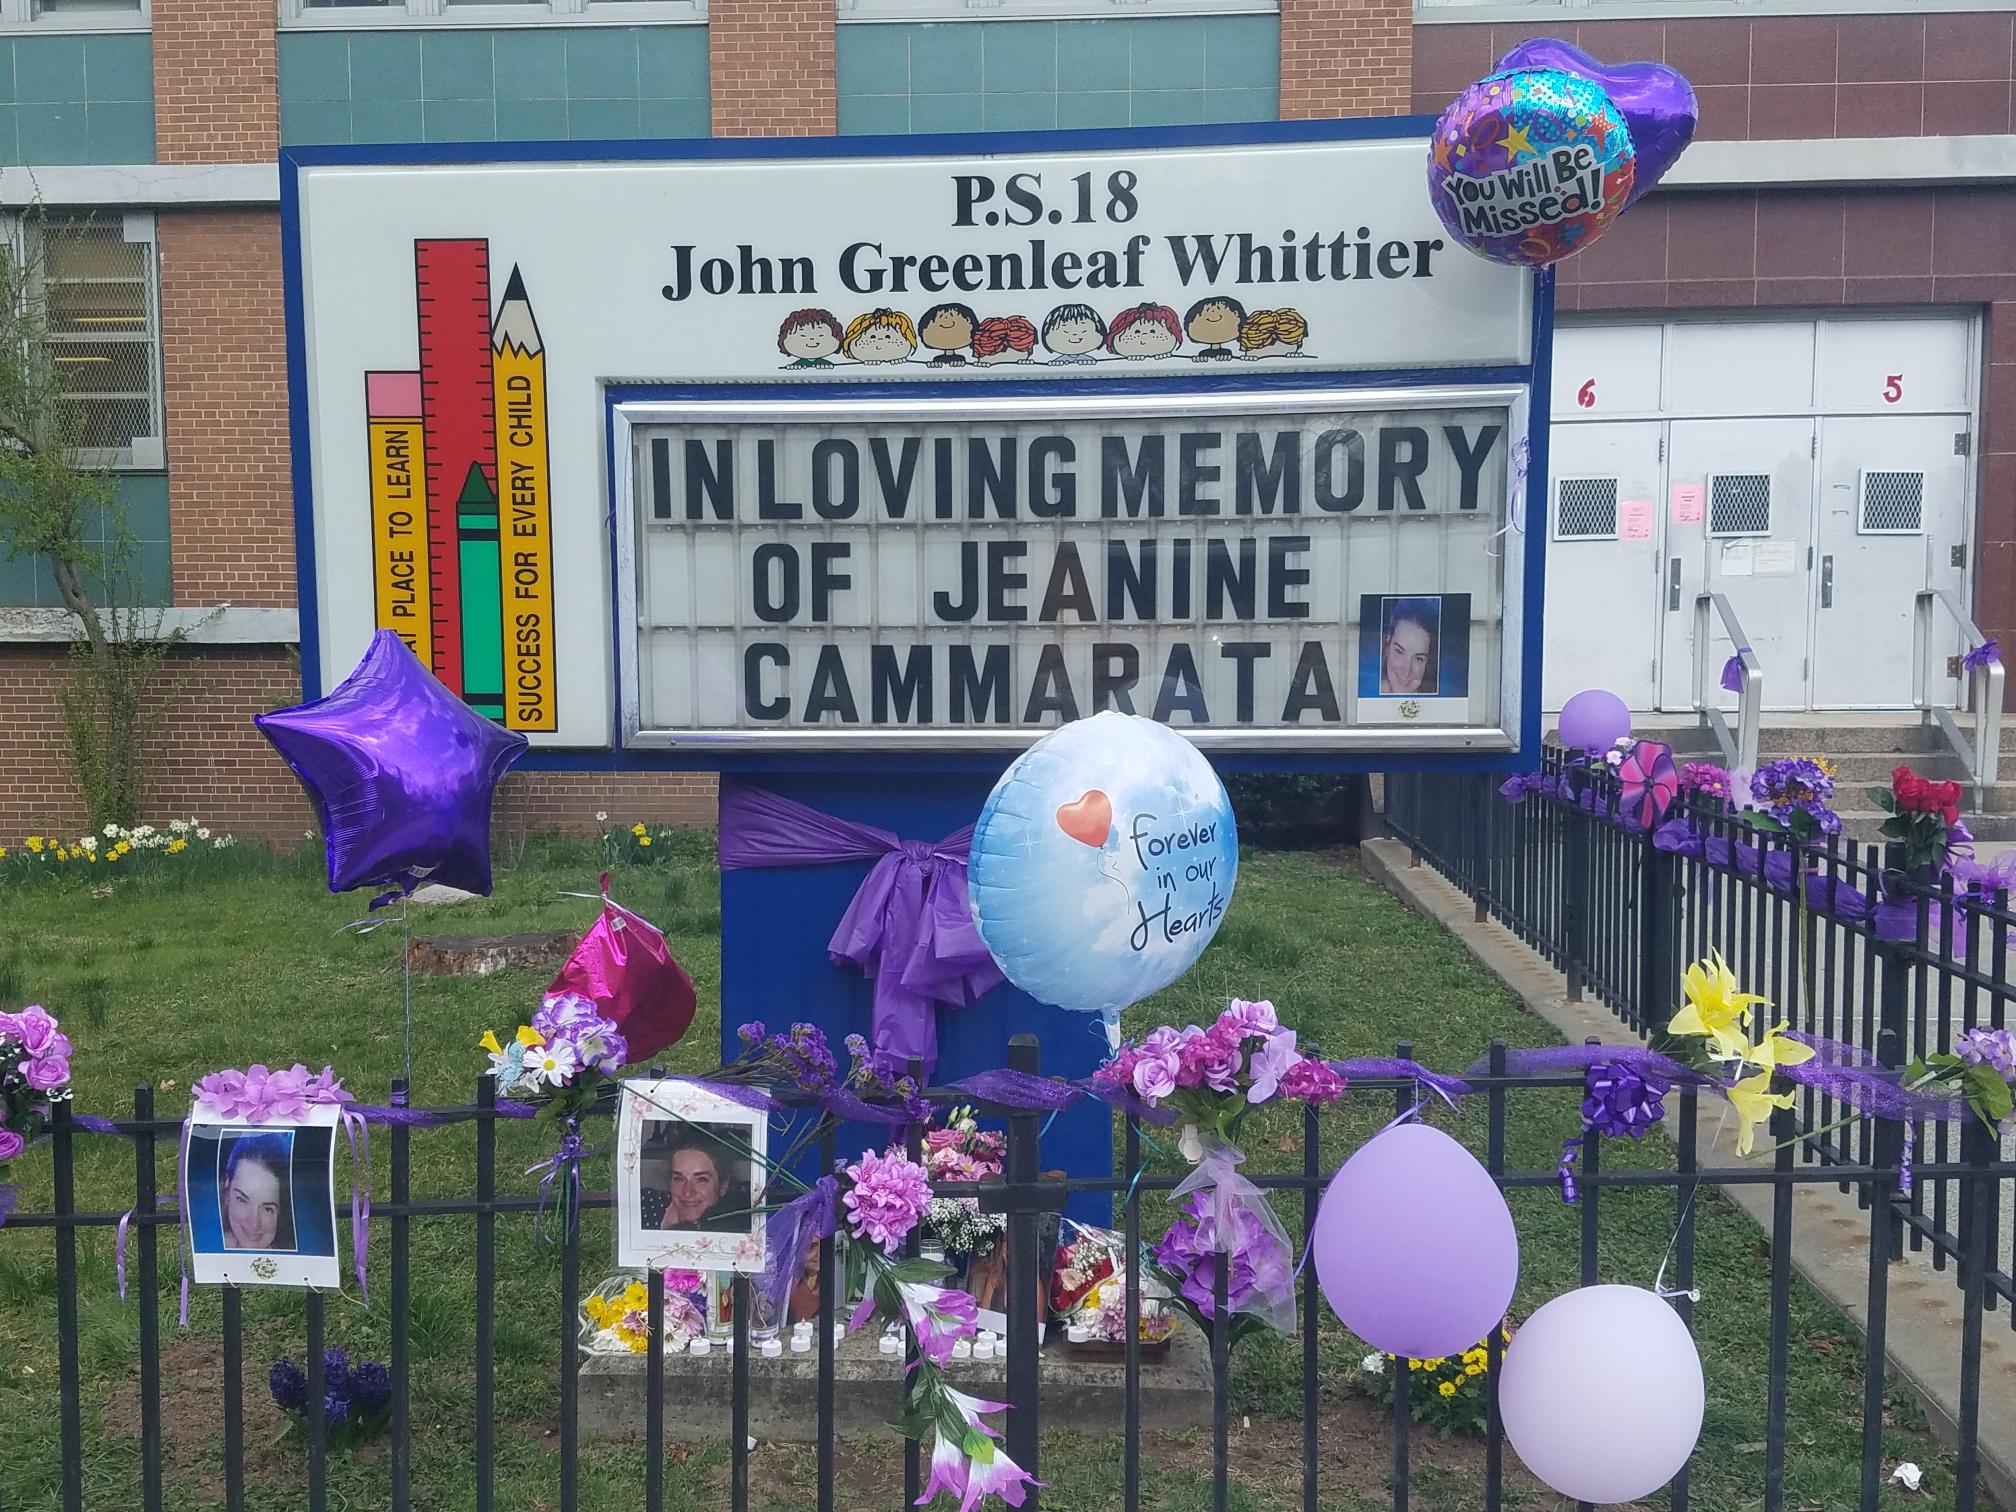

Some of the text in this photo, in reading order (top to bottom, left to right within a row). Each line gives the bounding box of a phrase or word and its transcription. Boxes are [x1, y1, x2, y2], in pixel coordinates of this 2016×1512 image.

[951, 170, 1139, 227] P.S.18
[1462, 167, 1604, 235] Missed!
[1499, 161, 1550, 200] Will
[1551, 148, 1594, 184] Be
[662, 226, 1445, 302] John Greenleaf Whittier
[1577, 379, 1597, 408] 6
[1883, 375, 1904, 403] 5
[384, 430, 412, 500] LEARN
[652, 424, 1503, 521] IN LOVING MEMORY
[388, 511, 413, 540] TO
[506, 374, 544, 723] SUCCESS FOR EVERY CHILD
[390, 549, 417, 618] PLACE
[752, 535, 1312, 623] OF JEANINE
[743, 640, 1343, 724] CAMMARATA
[1156, 856, 1217, 892] in our
[1129, 882, 1225, 952] Hearts
